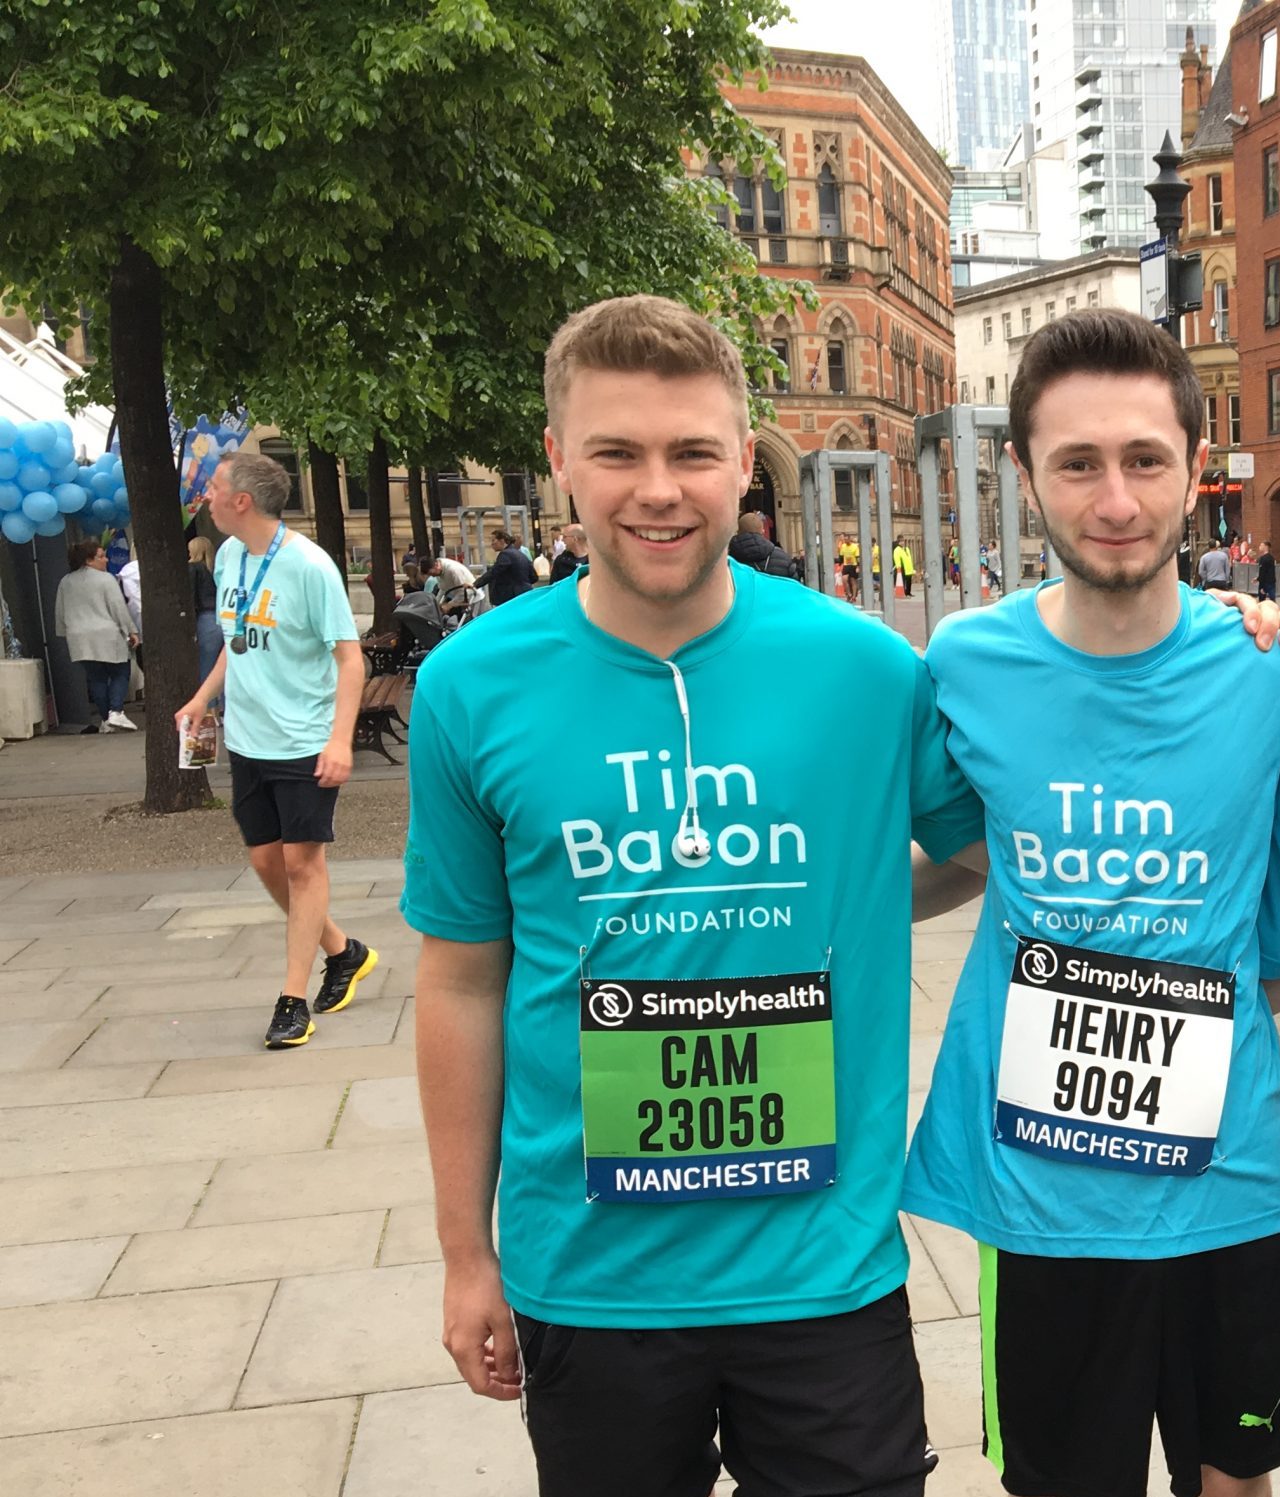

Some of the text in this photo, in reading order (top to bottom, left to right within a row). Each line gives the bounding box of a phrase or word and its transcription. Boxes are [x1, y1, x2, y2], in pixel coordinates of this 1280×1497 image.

[605, 749, 757, 813] Tim
[1049, 782, 1173, 835] Tim
[561, 818, 806, 879] Bacon
[1012, 830, 1209, 885] Bacon
[642, 984, 825, 1020] Simplyhealth
[1064, 959, 1230, 1005] Simplyhealth
[661, 1032, 758, 1089] CAM
[1049, 998, 1186, 1067] HENRY
[1053, 1061, 1162, 1126] 9094
[637, 1092, 784, 1152] 23058
[1015, 1117, 1189, 1167] MANCHESTER
[615, 1158, 810, 1192] MANCHESTER
